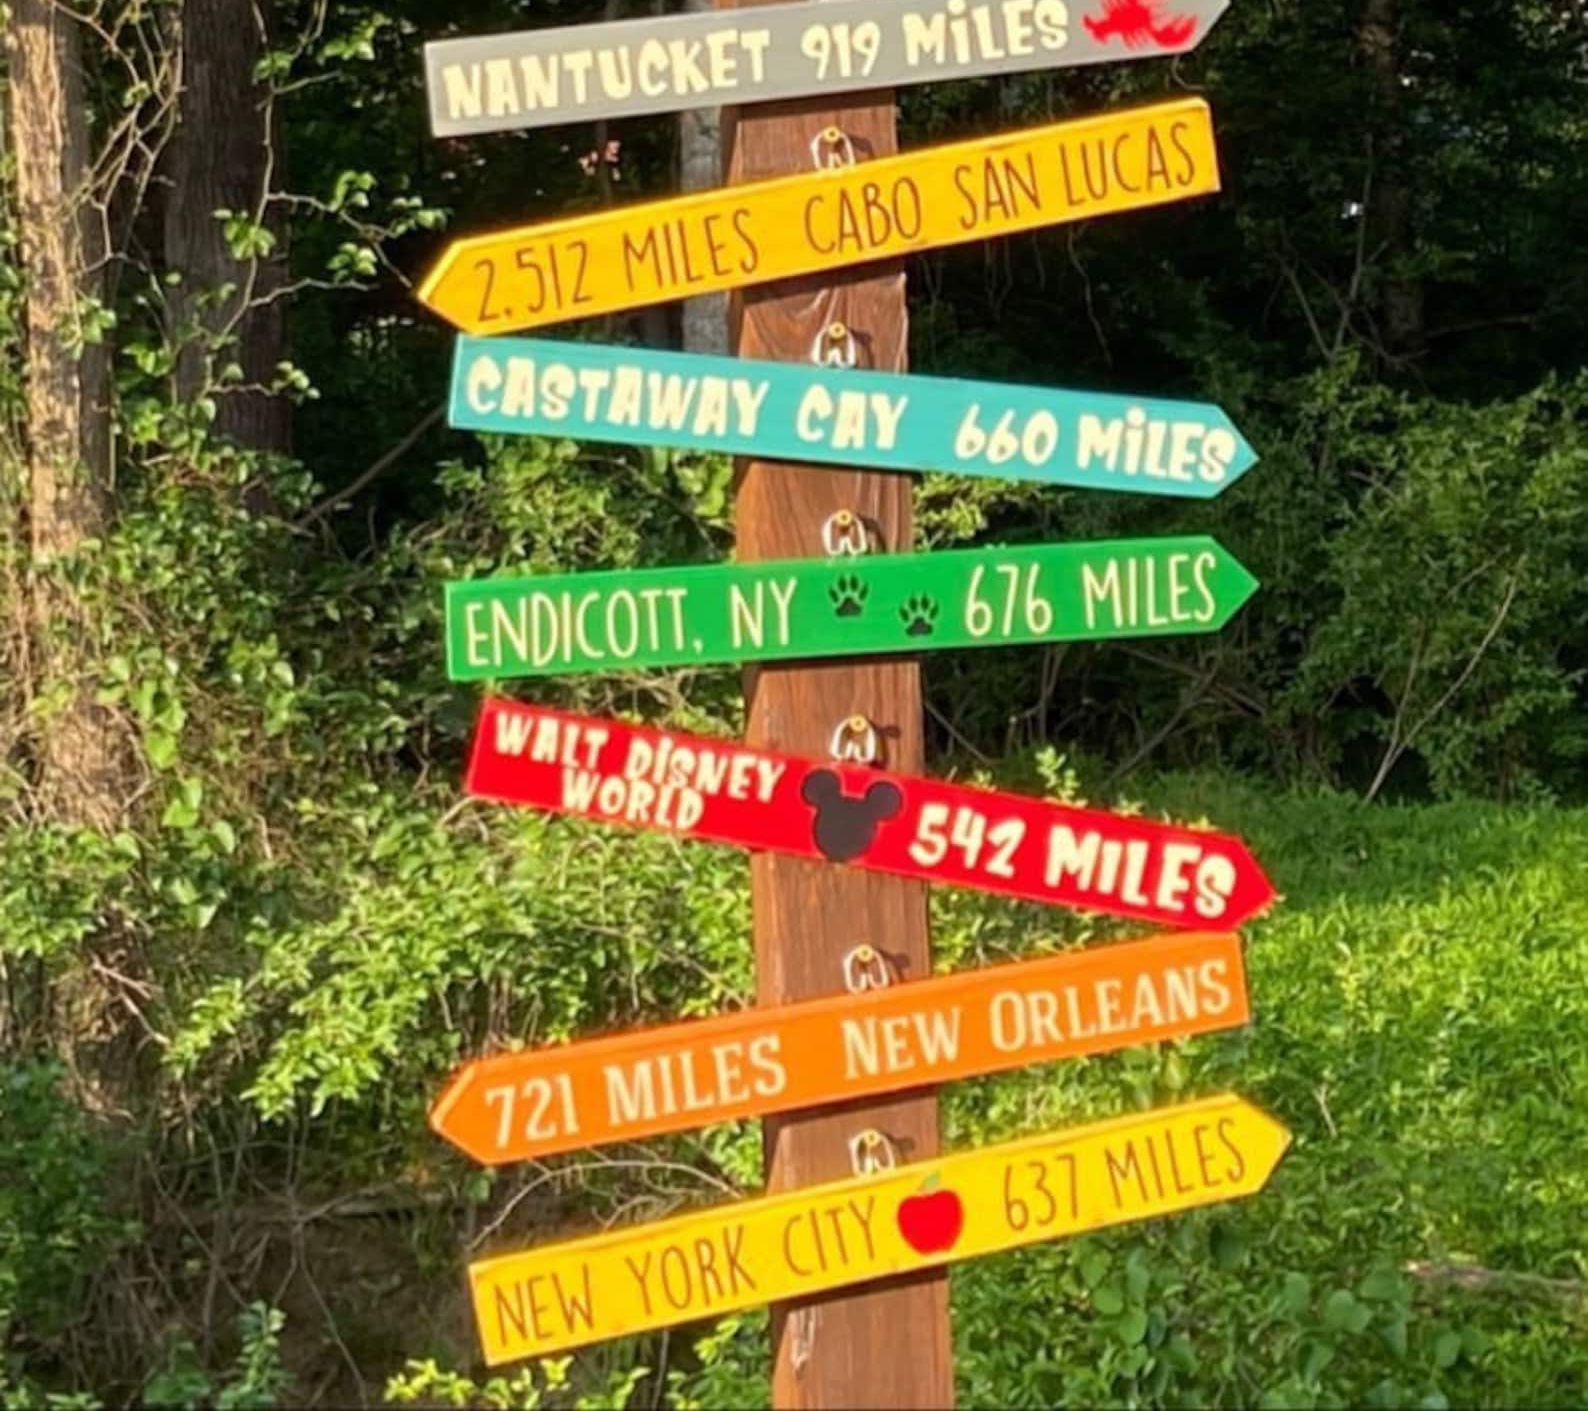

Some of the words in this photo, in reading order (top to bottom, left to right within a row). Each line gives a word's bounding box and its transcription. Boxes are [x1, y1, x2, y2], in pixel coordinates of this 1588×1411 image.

[442, 29, 770, 119] NANTUCKET
[801, 21, 881, 81] 919
[623, 208, 759, 292] MILES
[803, 177, 922, 255] CABO
[953, 152, 1042, 231] SAN
[1059, 121, 1195, 208] LUCAS
[466, 355, 770, 437] CASTAWAY
[796, 384, 908, 450] CAY
[955, 403, 1058, 466] 660
[730, 578, 798, 649] NY
[964, 563, 1053, 637] 676
[1082, 552, 1216, 629] MILES
[495, 711, 609, 768] WALT
[562, 766, 704, 830] WORLD
[908, 804, 1025, 878] 542
[1045, 825, 1237, 919] MILES
[486, 1073, 580, 1149] 721
[604, 1035, 786, 1127] MILES
[841, 1006, 960, 1079] NEW
[990, 958, 1230, 1052] ORLEANS
[1003, 1154, 1079, 1232] 637
[1105, 1117, 1245, 1209] MILES
[494, 1264, 594, 1347] NEW
[625, 1224, 757, 1316] YORK
[782, 1195, 876, 1278] CITY
